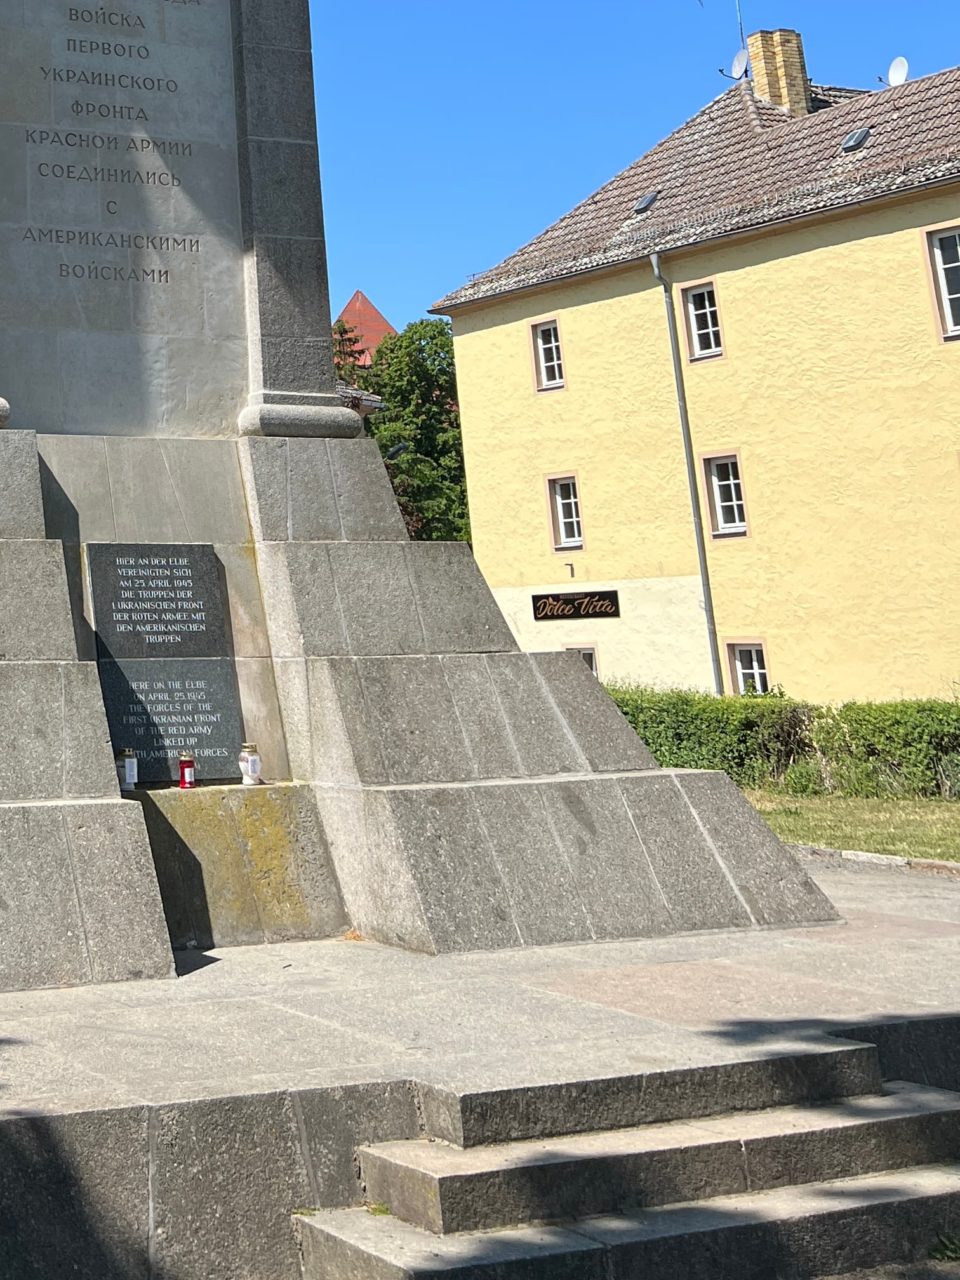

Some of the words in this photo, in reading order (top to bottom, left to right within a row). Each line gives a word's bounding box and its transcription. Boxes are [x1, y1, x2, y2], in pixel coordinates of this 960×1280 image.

[68, 7, 146, 29] ВОЙСКА
[66, 38, 150, 60] ПЕРВОГО
[39, 66, 178, 93] УКРАИНСКОГО
[71, 99, 149, 122] ФРОНТА
[126, 138, 192, 157] АРМИИ
[37, 162, 182, 187] СОЕДИНИЛИСЬ
[106, 200, 118, 215] С
[22, 227, 201, 253] АМЕРИКАНСКИМИ
[58, 260, 169, 284] ВОЙСКАМИ
[116, 557, 135, 565] HIER
[137, 557, 149, 565] AN
[151, 557, 167, 565] DER
[169, 557, 190, 565] ELBE
[117, 568, 171, 577] VEREINIGTEN
[173, 568, 192, 577] SICH
[119, 580, 132, 588] AM
[147, 579, 172, 588] APRIL
[174, 579, 193, 588] 1945
[121, 590, 135, 598] DIE
[138, 590, 175, 598] TRUPPEN
[176, 590, 193, 598] DER
[117, 601, 176, 610] UKRAINISCHEN
[178, 601, 204, 609] FRONT
[536, 597, 574, 617] Dolce
[575, 595, 616, 615] Vita
[113, 612, 130, 620] DER
[132, 612, 159, 620] ROTEN
[161, 612, 189, 620] ARMEE
[191, 612, 206, 620] MIT
[116, 624, 133, 632] DEN
[135, 623, 206, 632] AMERIKANISCHEN
[144, 634, 182, 643] TRUPPEN
[153, 681, 165, 690] ON
[168, 680, 182, 689] THE
[185, 680, 208, 689] ELBE
[148, 692, 171, 700] APRIL
[129, 704, 145, 713] THE
[147, 702, 180, 712] FORCES
[183, 702, 193, 711] OF
[198, 702, 214, 711] THE
[194, 713, 221, 722] FRONT
[168, 725, 186, 735] RED
[187, 725, 213, 736] ARMY
[153, 738, 185, 747] LINKED
[186, 737, 198, 746] UP
[195, 747, 229, 757] FORCES
